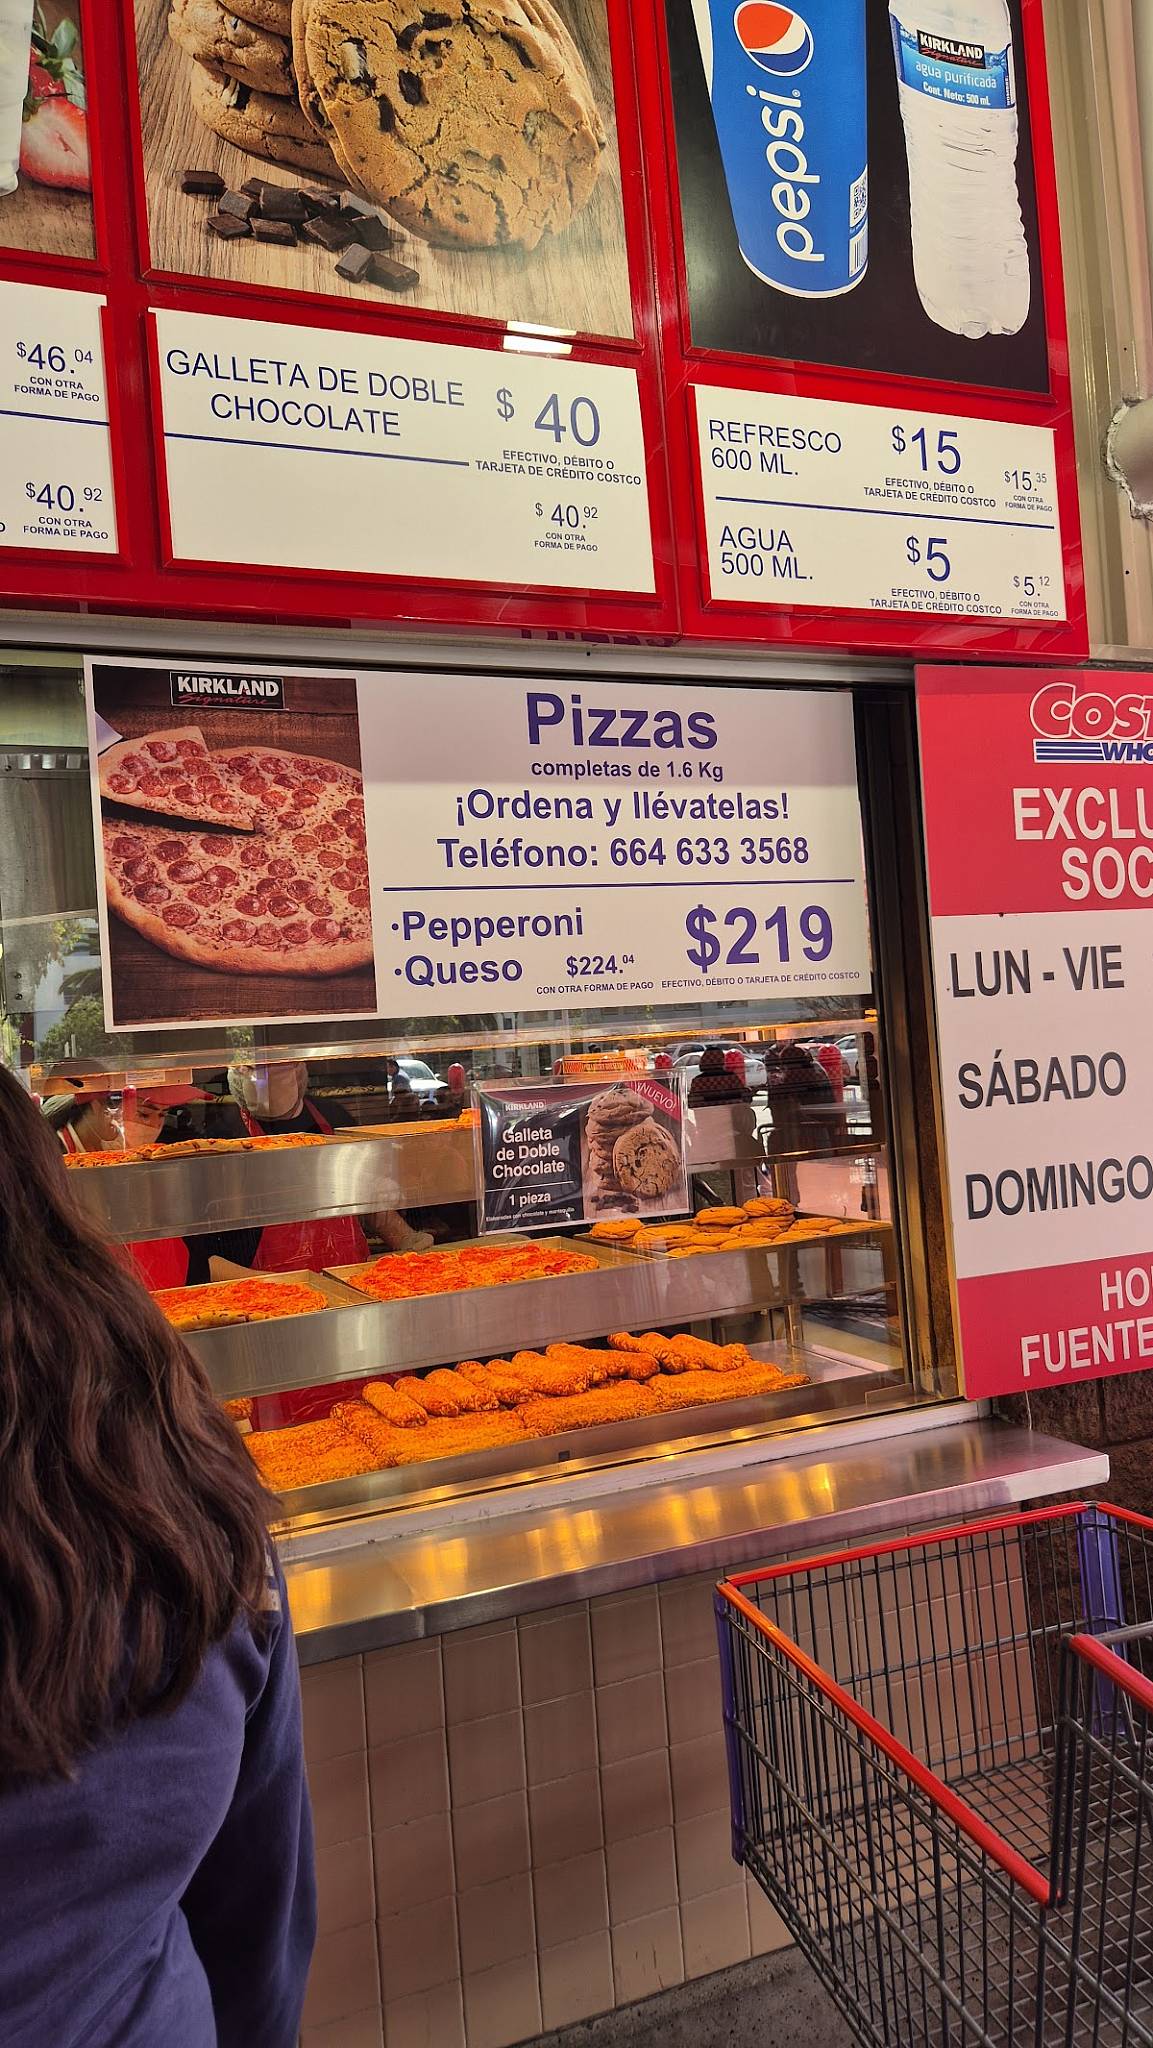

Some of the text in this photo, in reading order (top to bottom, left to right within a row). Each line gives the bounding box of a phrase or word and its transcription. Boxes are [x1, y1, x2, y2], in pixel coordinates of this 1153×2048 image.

[920, 34, 983, 59] KIRKLAND
[915, 61, 996, 88] agua purificada
[944, 88, 965, 102] Neto:
[966, 93, 979, 105] 500
[746, 84, 824, 262] pepsi
[16, 341, 93, 373] $46.04
[30, 376, 84, 390] CON OTRA
[167, 349, 464, 407] GALLETA DE DOBLE
[14, 384, 99, 402] FORMA DE PAGO
[211, 393, 401, 437] CHOCOLATE
[709, 419, 841, 454] REFRESCO
[503, 450, 615, 470] EFECTIVO, DÉBITO O
[891, 425, 961, 475] $15
[476, 460, 641, 485] TARJETA DE CRÉDITO COSTCO
[711, 448, 799, 476] 600 ML.
[885, 477, 974, 494] EFECTIVO, DÉBITO O
[25, 482, 102, 512] $40.92
[864, 486, 996, 508] TARJETA DE CRÉDITO COSTCO
[1005, 502, 1052, 512] FORMA DE PAGO
[23, 526, 108, 539] FORMA DE PAGO
[39, 517, 92, 528] CON OTRA
[534, 541, 598, 552] FORMA DE PAGO
[545, 532, 586, 542] CON OTRA
[719, 525, 793, 553] AGUA
[721, 553, 812, 580] 500 ML.
[906, 535, 950, 581] $5
[891, 588, 980, 602] EFECTIVO, DÉBITO O
[1034, 601, 1049, 609] OTRA
[870, 599, 1001, 614] TARJETA DE CRÉDITO COSTCO
[1011, 608, 1032, 616] FORMA
[178, 676, 279, 696] KIRKLAND
[178, 693, 271, 706] Signature
[526, 691, 718, 750] Pizzas
[531, 760, 723, 782] completas de 1.6 Kg
[456, 789, 789, 827] ¡Ordena y llévatelas!
[437, 837, 809, 868] Teléfono: 664 633 3568
[1061, 846, 1153, 900] SOC
[685, 903, 833, 973] $219
[661, 979, 704, 988] EFECTIVO,
[705, 977, 735, 986] DÉBITO
[745, 975, 779, 984] TARJETA
[781, 974, 791, 982] DE
[793, 972, 827, 981] CRÉDITO
[829, 972, 860, 980] COSTCO
[950, 949, 1031, 997] LUN
[1063, 945, 1124, 991] VIE
[537, 981, 653, 994] CON OTRA FORMA DE PAGO
[958, 1049, 1126, 1110] SÁBADO
[505, 1101, 545, 1111] KIRKLAND
[502, 1127, 552, 1143] Galleta
[496, 1143, 560, 1161] de Doble
[493, 1161, 565, 1179] Chocolate
[965, 1155, 1153, 1220] DOMINGO
[509, 1192, 551, 1208] 1 pieza
[1101, 1265, 1153, 1311] HO
[1020, 1316, 1153, 1376] FUENTE
